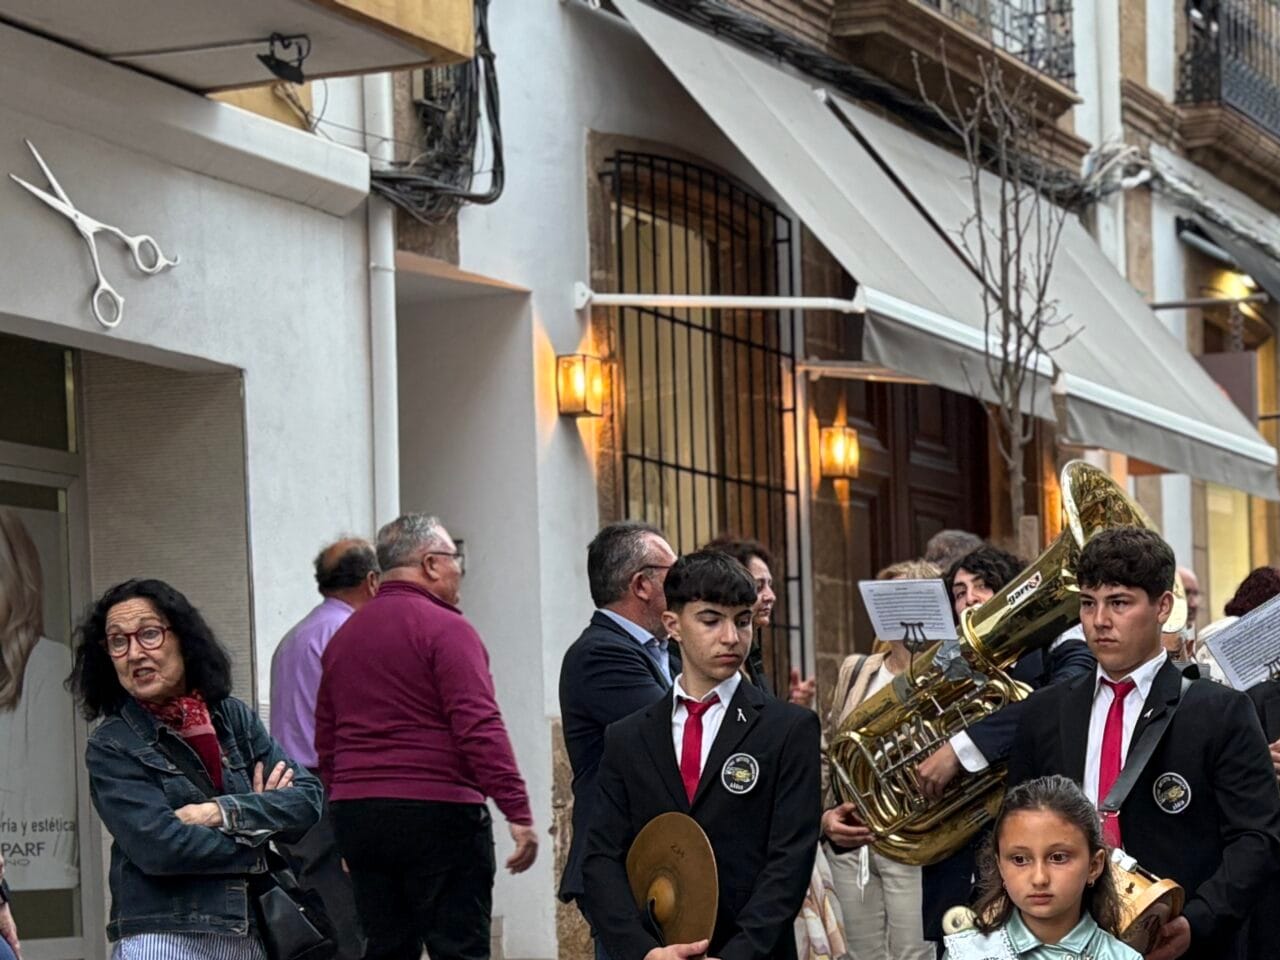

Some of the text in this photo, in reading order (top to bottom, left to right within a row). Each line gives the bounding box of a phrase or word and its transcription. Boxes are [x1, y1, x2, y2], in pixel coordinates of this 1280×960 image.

[0, 818, 76, 837] ría y estética
[0, 842, 46, 858] PARF
